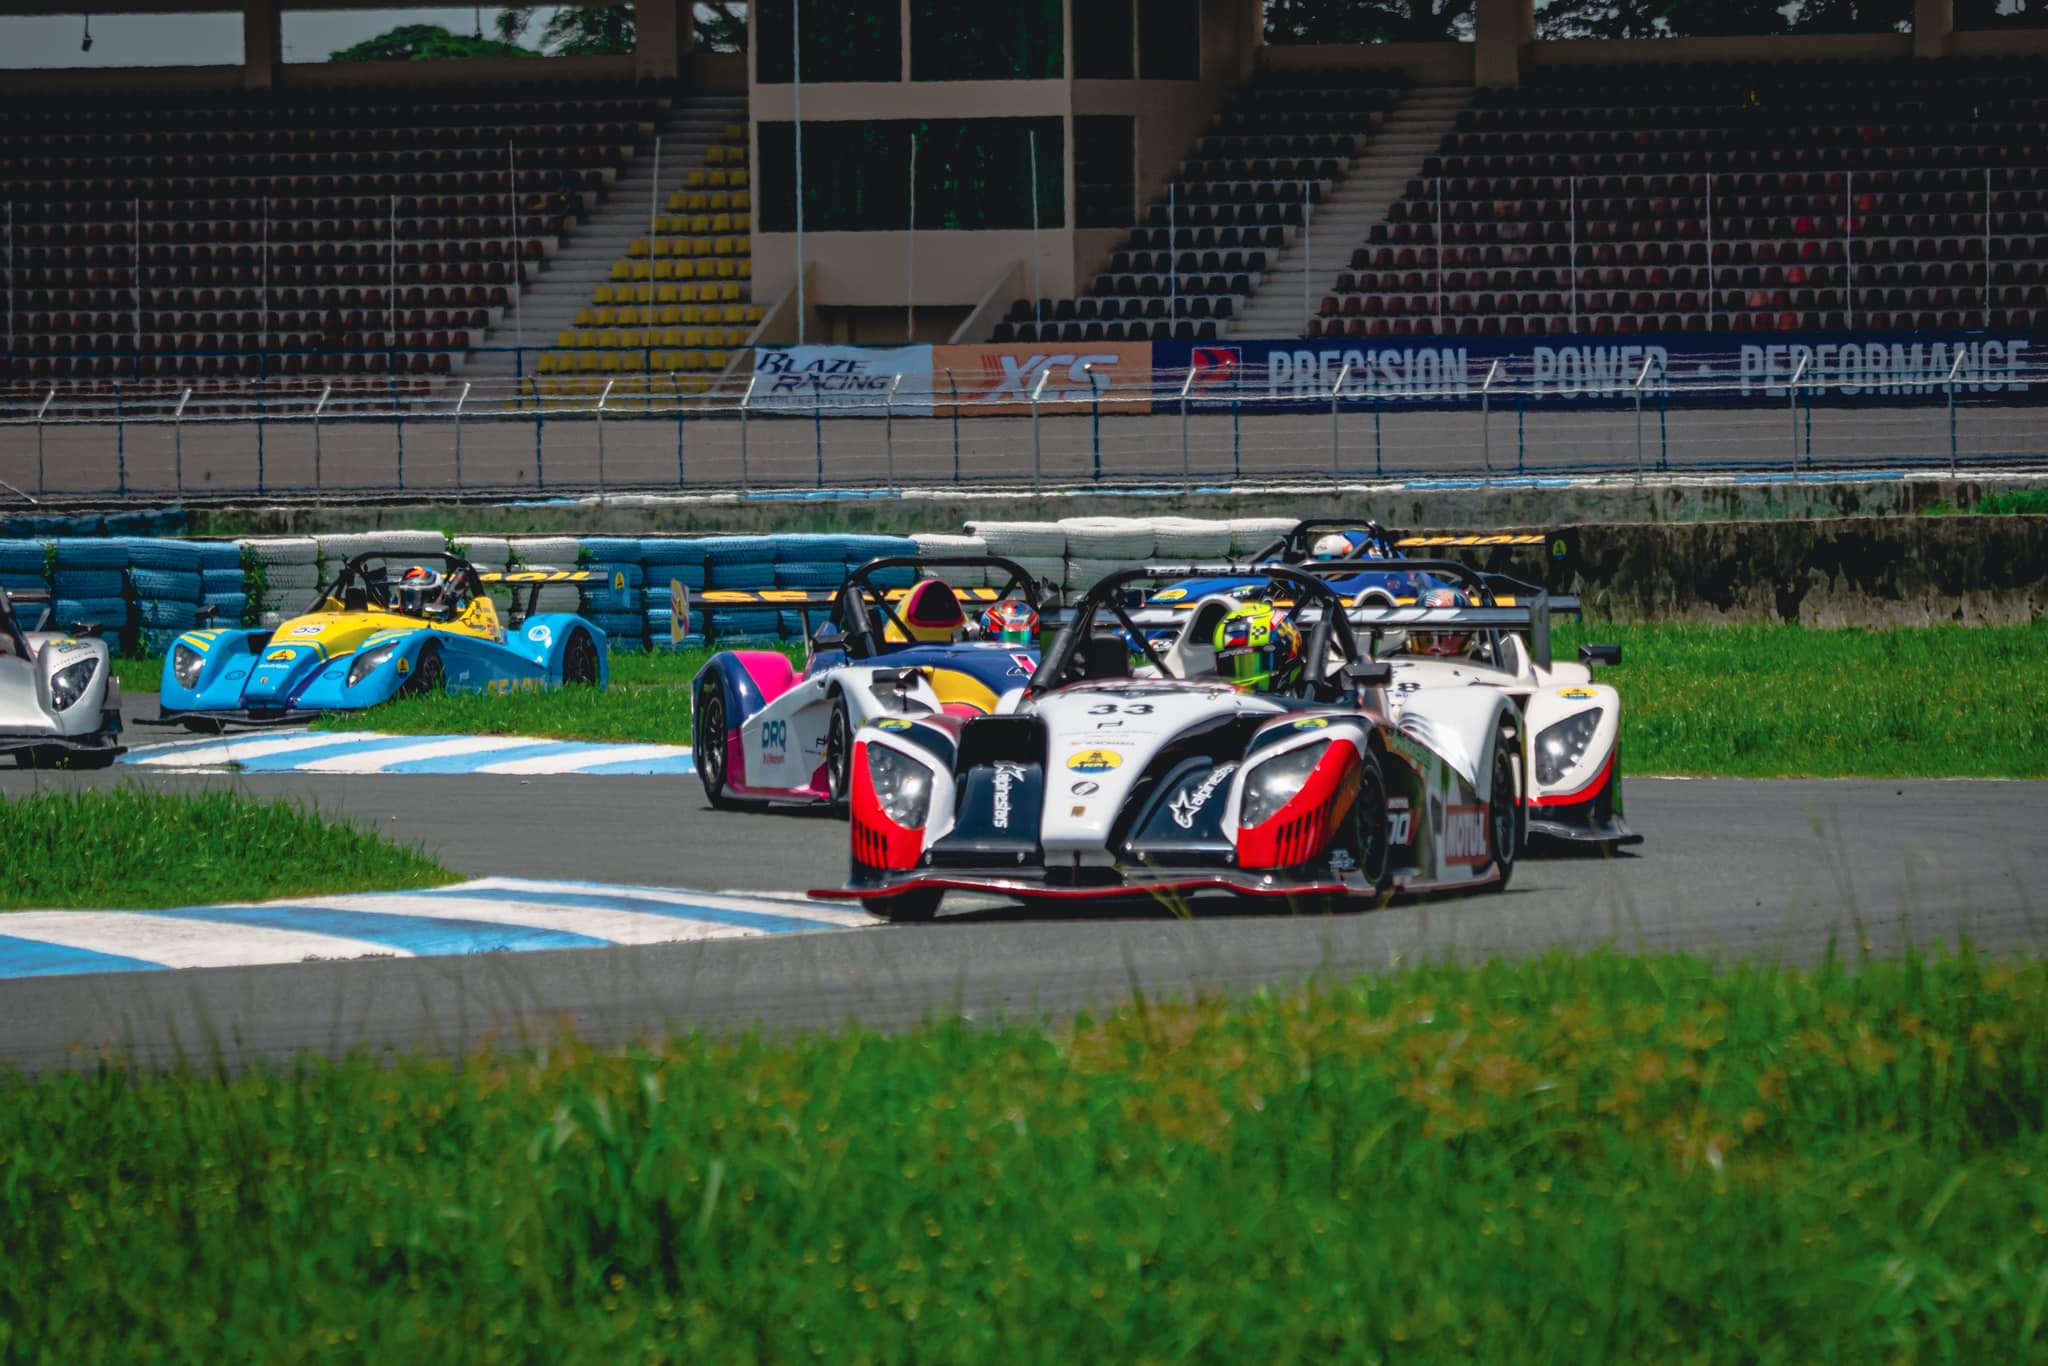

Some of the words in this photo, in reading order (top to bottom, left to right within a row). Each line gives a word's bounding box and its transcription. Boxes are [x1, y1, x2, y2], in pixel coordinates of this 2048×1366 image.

[757, 352, 871, 375] BLAZE
[986, 354, 1120, 401] XCS
[1268, 348, 1467, 401] PRECISION
[1533, 345, 1668, 400] POWER
[1741, 340, 2029, 397] PERFORMANCE
[771, 375, 891, 392] RACING
[1088, 704, 1154, 715] 33
[761, 720, 786, 752] DRQ
[1447, 812, 1487, 857] MOTUL
